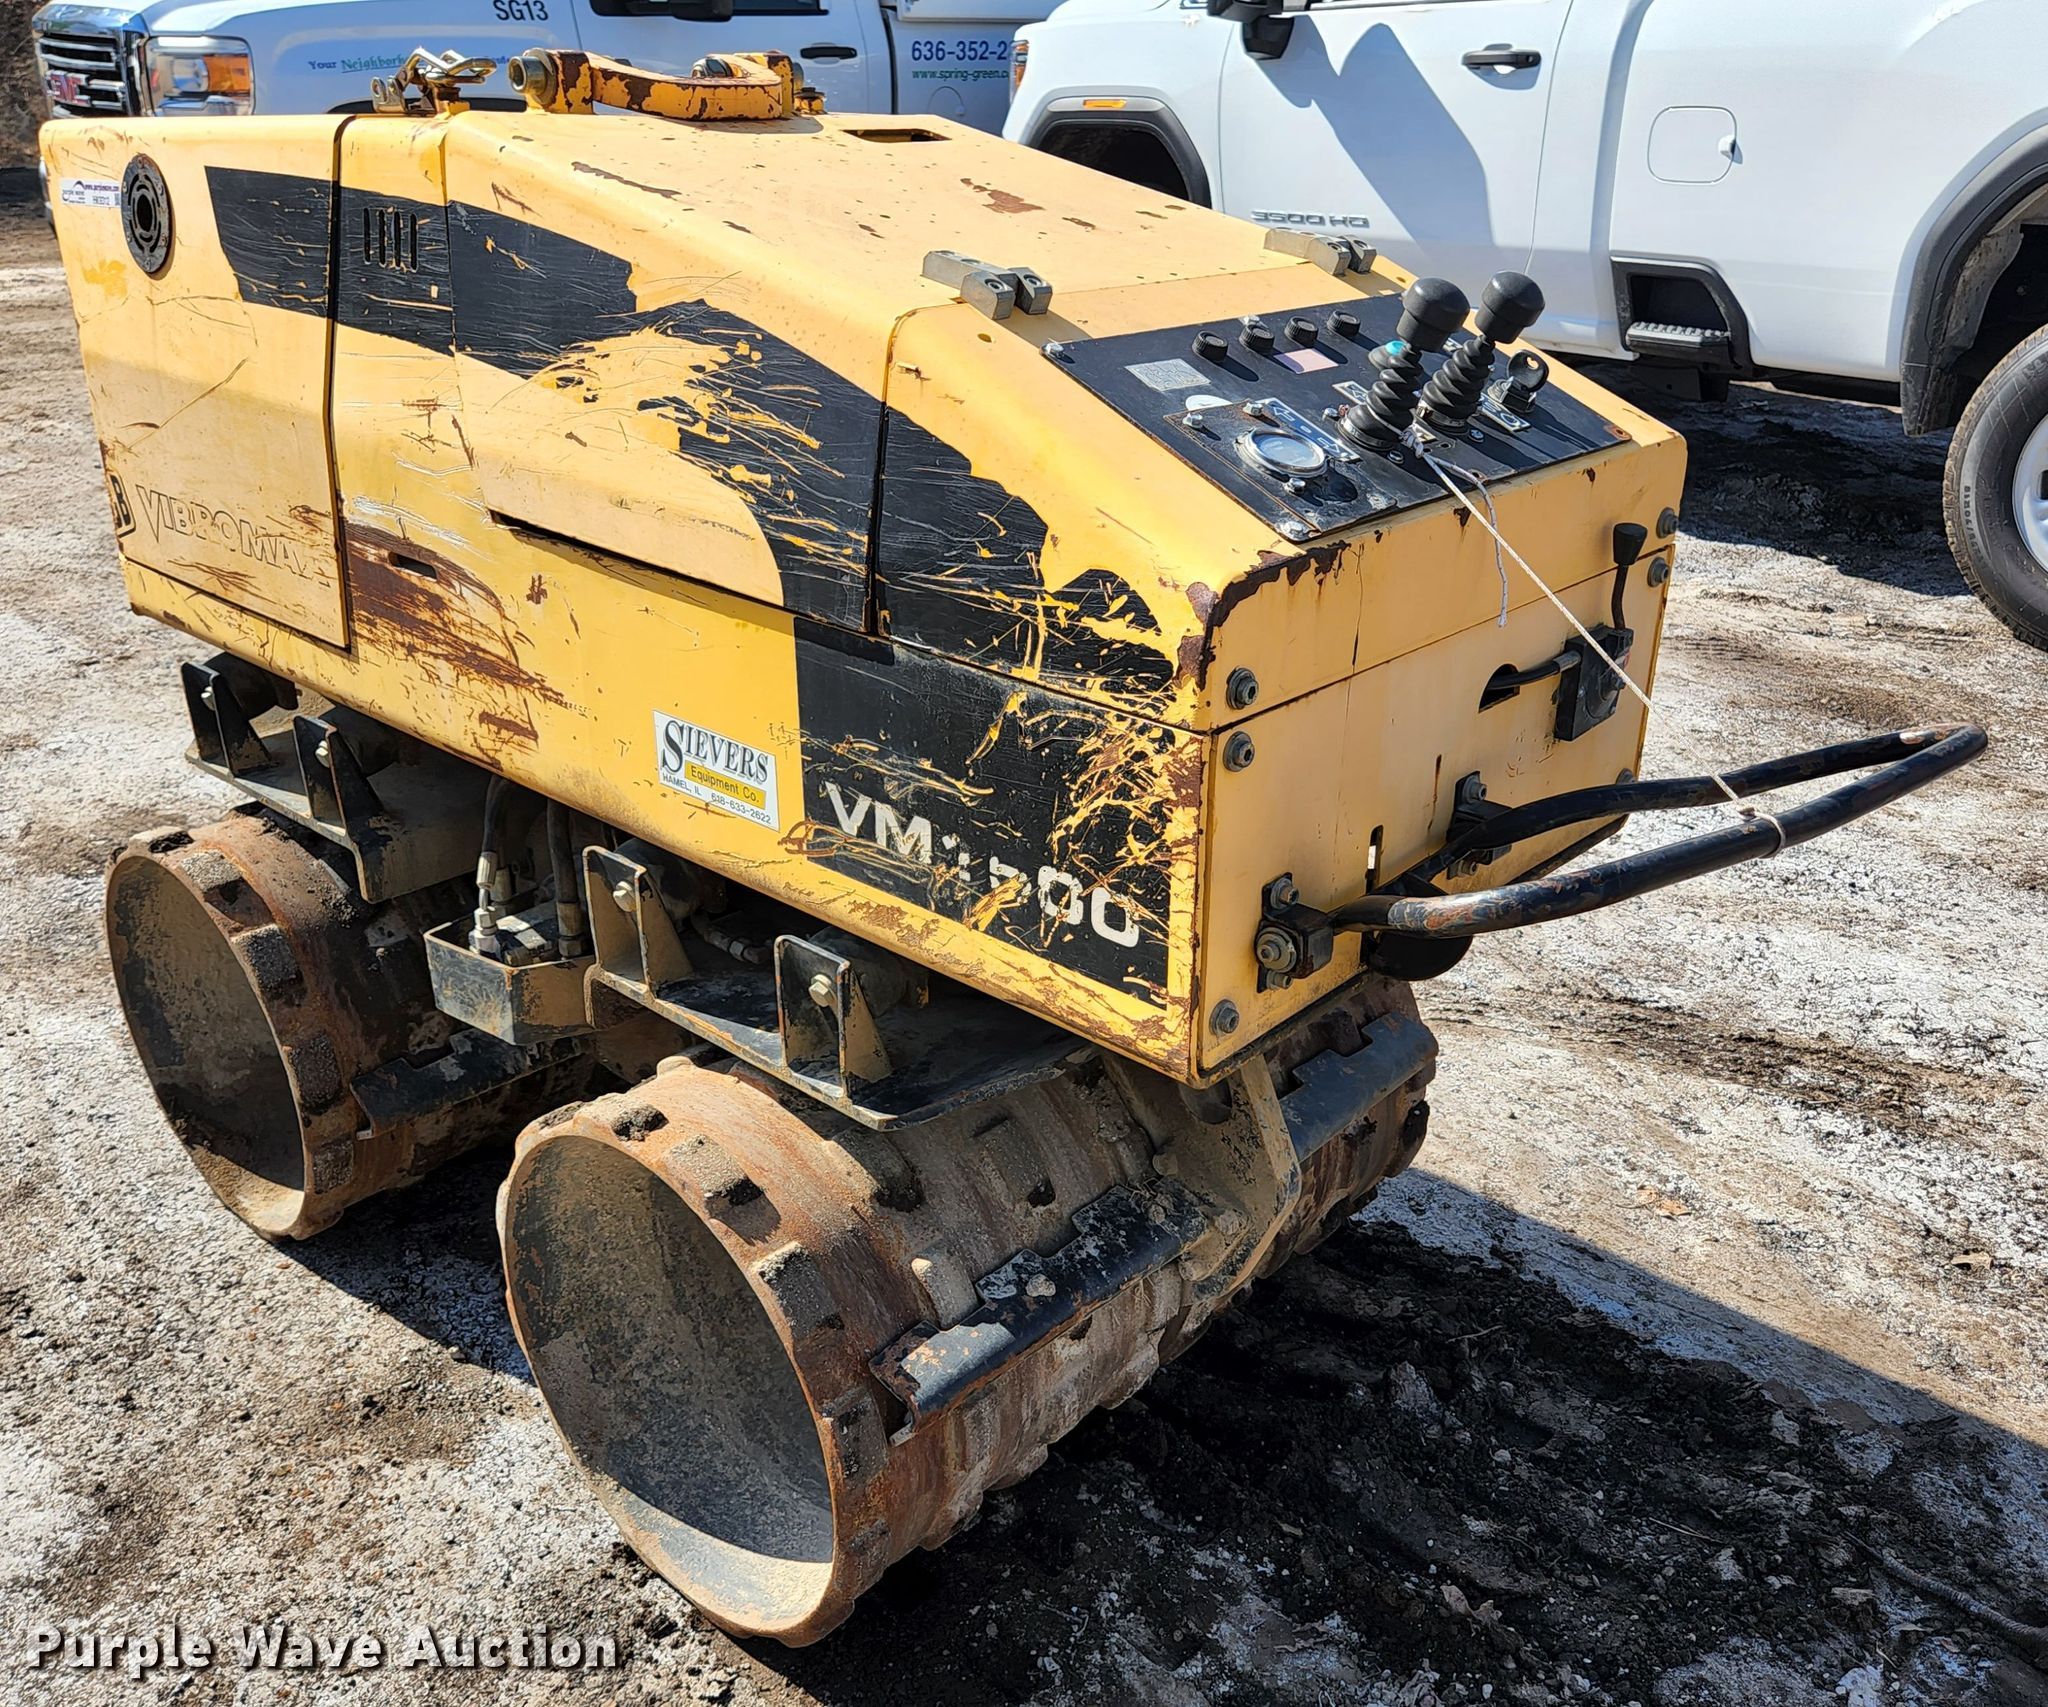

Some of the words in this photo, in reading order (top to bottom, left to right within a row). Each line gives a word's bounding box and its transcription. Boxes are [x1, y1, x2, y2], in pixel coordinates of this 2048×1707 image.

[493, 0, 549, 21] SG13
[911, 40, 1011, 61] 636-352-2
[308, 61, 337, 70] Your
[1251, 211, 1326, 226] 3500
[1329, 215, 1371, 228] HD
[661, 720, 768, 784] SIEVERS
[691, 765, 739, 796] Equipment
[743, 786, 759, 803] Co.
[662, 773, 692, 793] HAMEL,
[694, 785, 702, 796] IL
[711, 792, 771, 824] 618-633-2622
